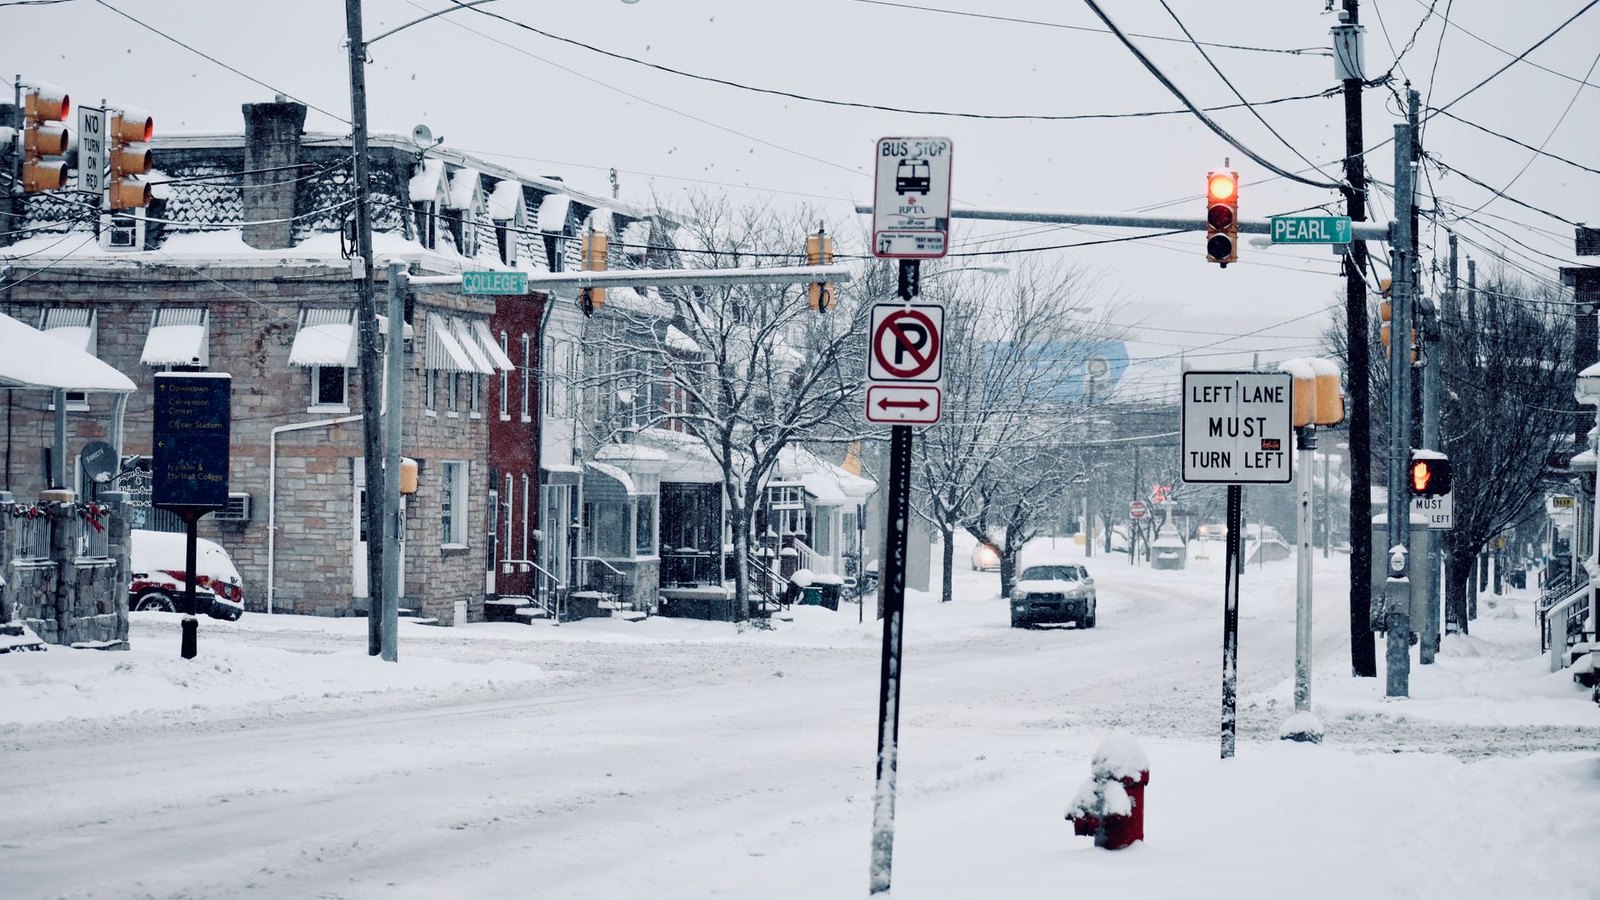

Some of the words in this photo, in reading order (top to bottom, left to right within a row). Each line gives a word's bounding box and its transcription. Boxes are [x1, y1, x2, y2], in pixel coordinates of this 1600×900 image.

[85, 114, 99, 134] NO
[84, 137, 100, 153] TURN
[882, 142, 908, 157] BUS
[915, 142, 946, 157] STOP
[87, 156, 97, 170] ON
[86, 173, 98, 190] RED
[1275, 220, 1330, 240] PEARL
[1336, 220, 1346, 231] ST
[464, 274, 518, 292] COLLEGE
[1193, 386, 1232, 403] LEFT
[1243, 386, 1284, 403] LANE
[195, 421, 223, 429] Stadium
[1209, 417, 1267, 438] MUST
[1190, 452, 1231, 468] TURN
[1245, 452, 1284, 468] LEFT
[197, 472, 224, 482] College
[1416, 500, 1442, 509] MUST
[1431, 515, 1449, 523] LEFT
